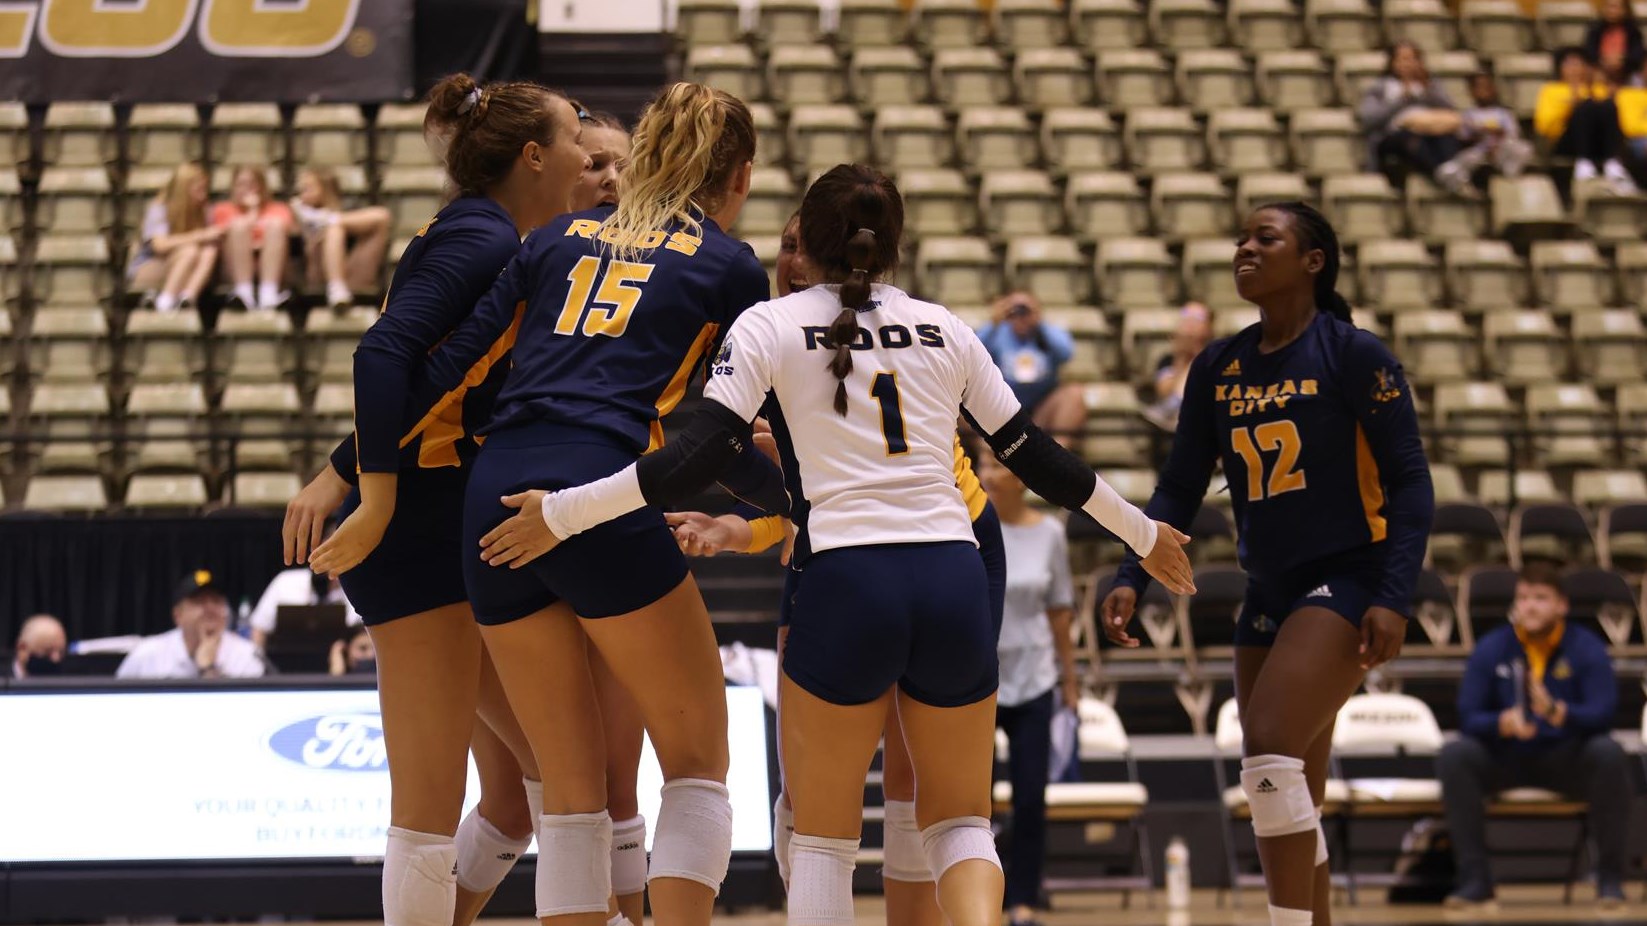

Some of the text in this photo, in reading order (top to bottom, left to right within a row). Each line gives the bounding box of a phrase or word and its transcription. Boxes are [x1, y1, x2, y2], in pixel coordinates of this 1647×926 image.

[554, 255, 656, 338] 15
[869, 370, 911, 457] 1
[1215, 379, 1318, 401] KANSAS
[1229, 395, 1292, 417] CITY
[1231, 419, 1307, 502] 12
